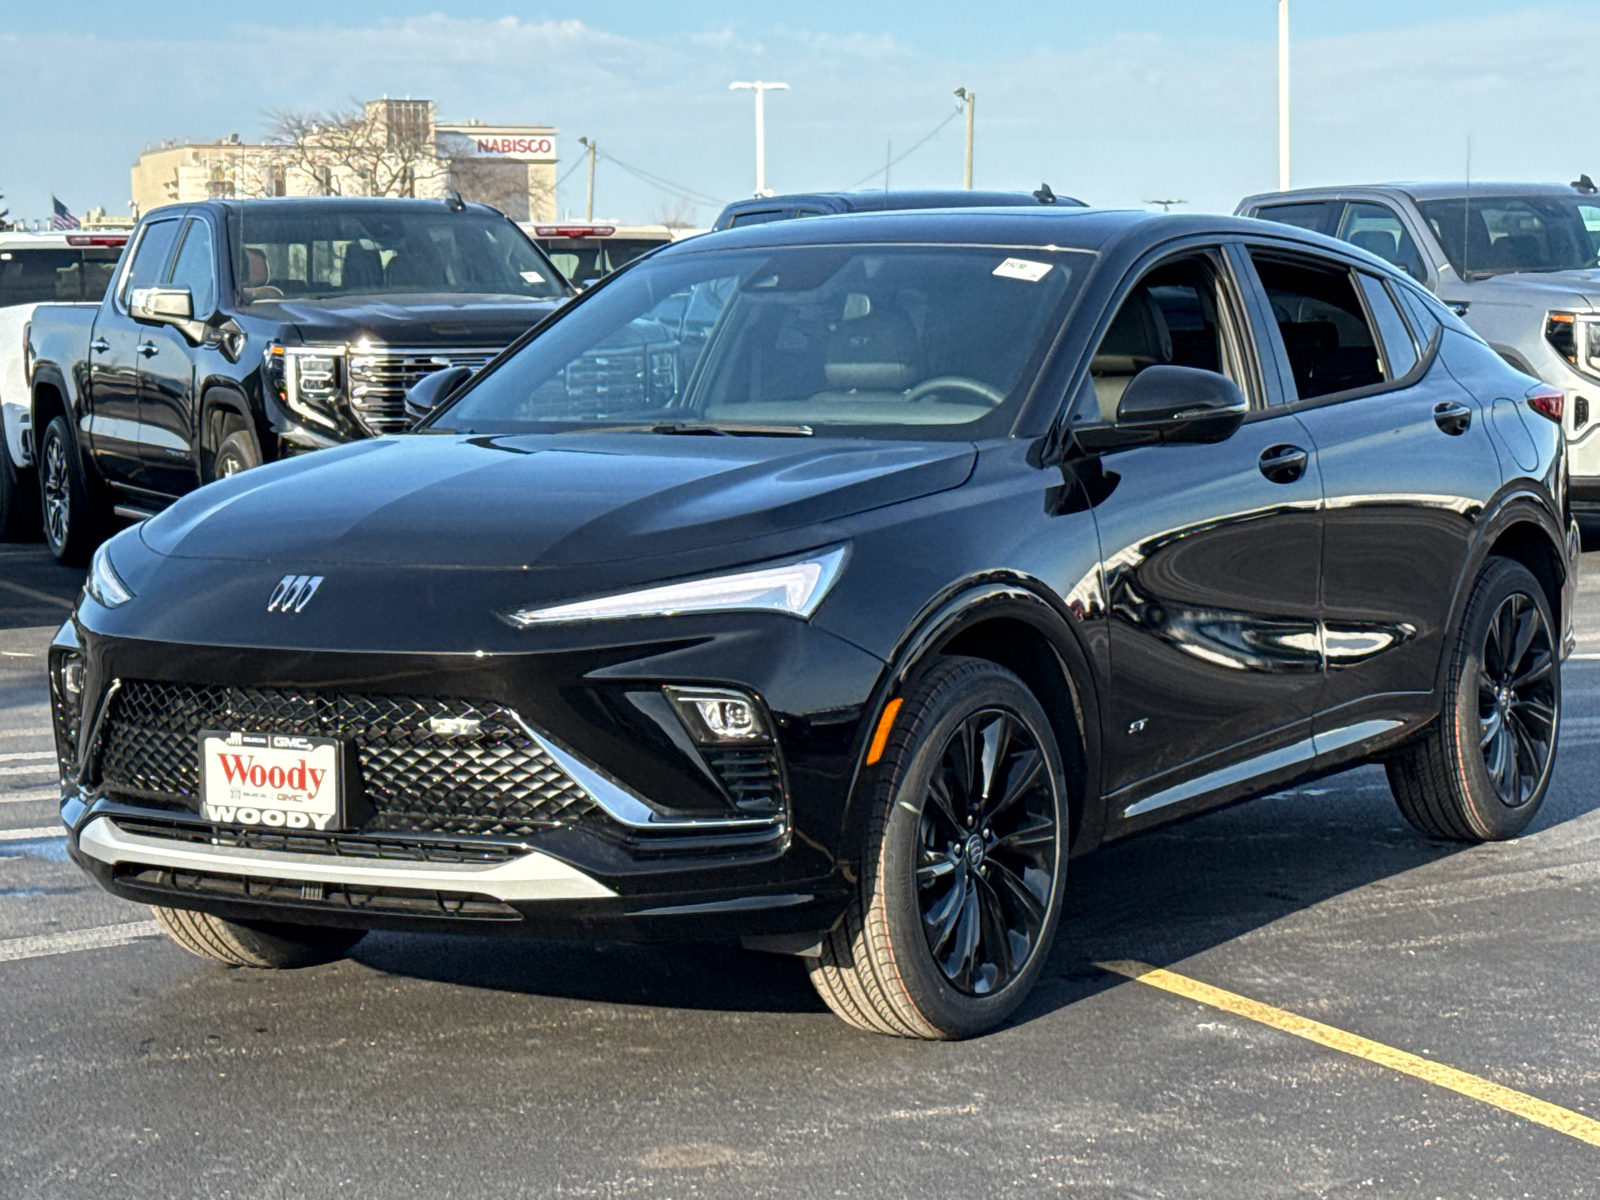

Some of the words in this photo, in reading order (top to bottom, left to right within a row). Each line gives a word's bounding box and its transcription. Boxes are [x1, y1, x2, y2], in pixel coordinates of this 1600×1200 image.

[477, 138, 552, 154] NABISCO
[273, 736, 310, 748] GMC
[216, 753, 327, 800] Woody
[276, 793, 303, 803] GMC
[206, 805, 332, 830] WOODY
